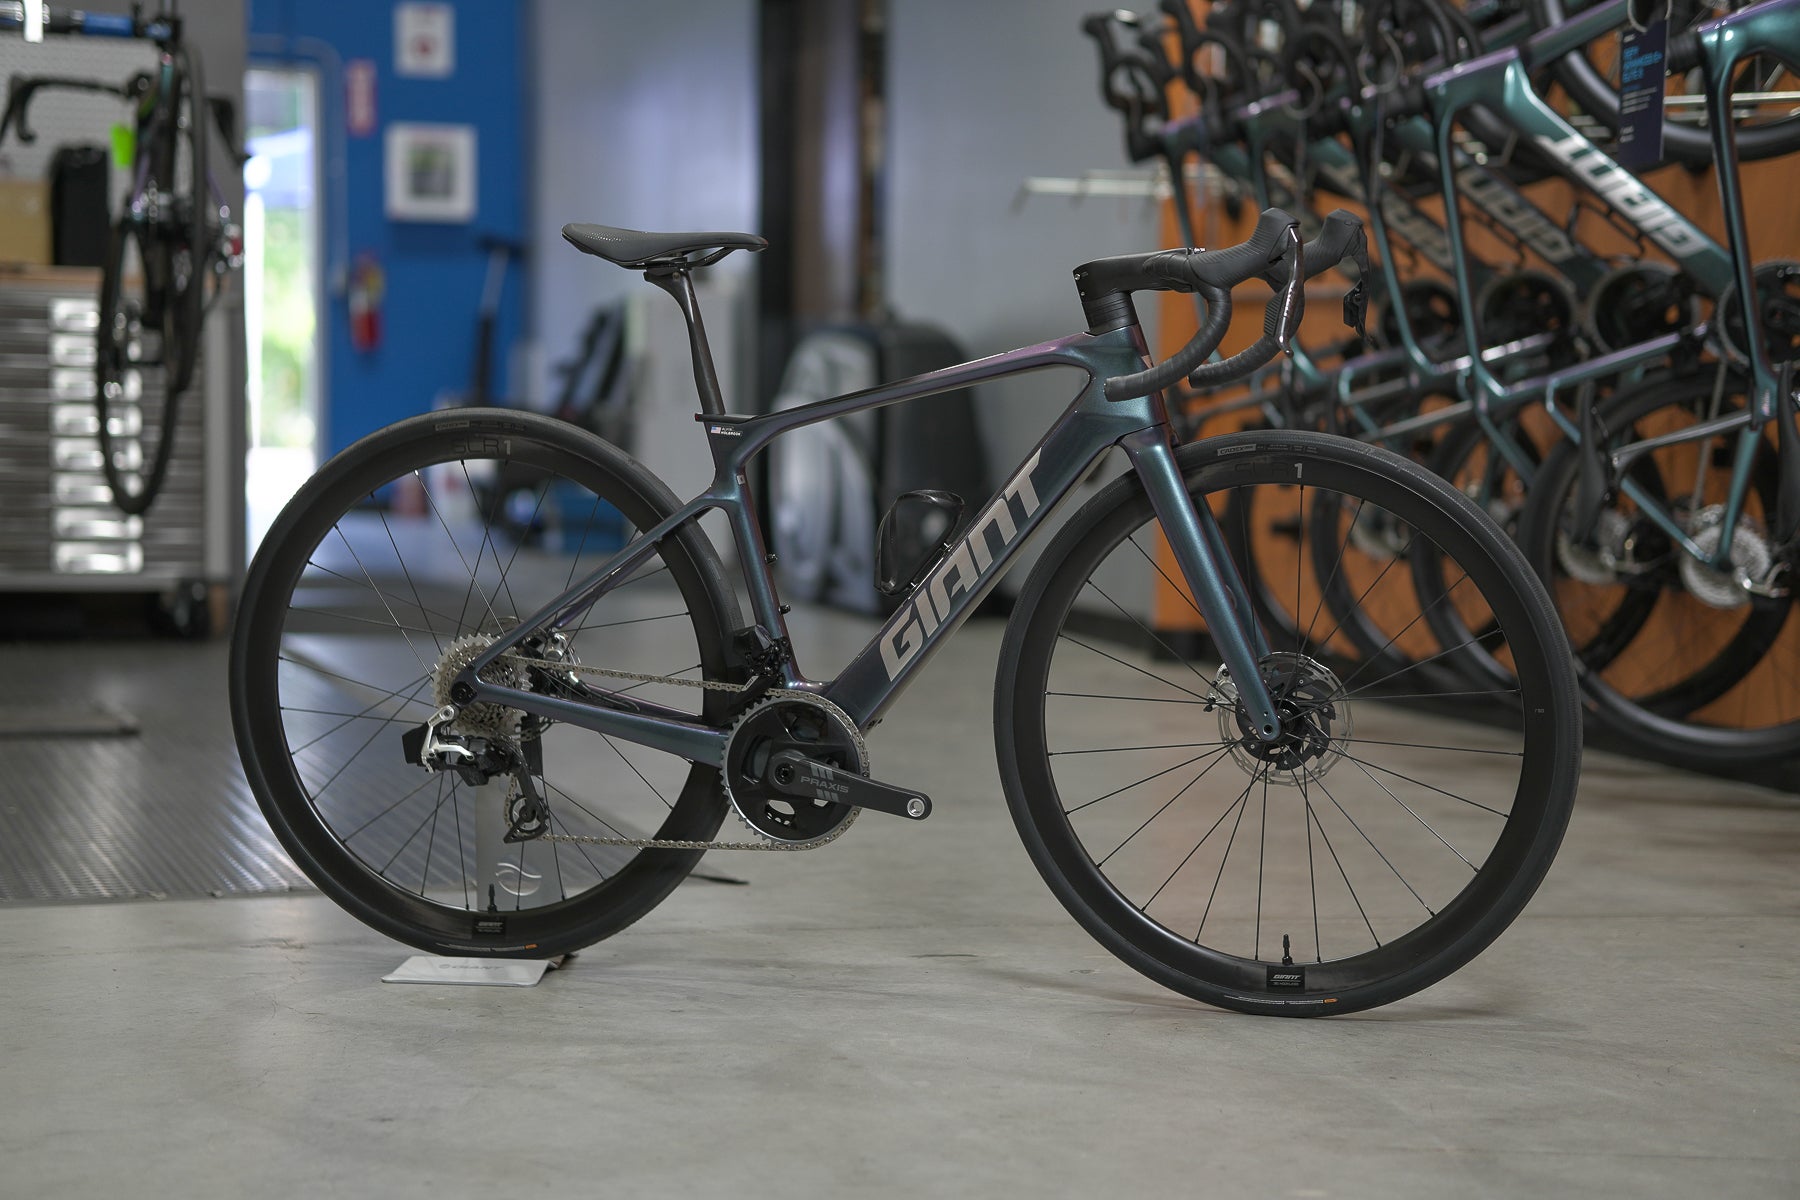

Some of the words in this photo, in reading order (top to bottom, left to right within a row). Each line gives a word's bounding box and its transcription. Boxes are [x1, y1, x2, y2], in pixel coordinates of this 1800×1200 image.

[1537, 132, 1711, 257] GIANT
[1293, 462, 1304, 479] 1
[879, 447, 1042, 682] GIANT
[800, 775, 851, 794] PRAXIS
